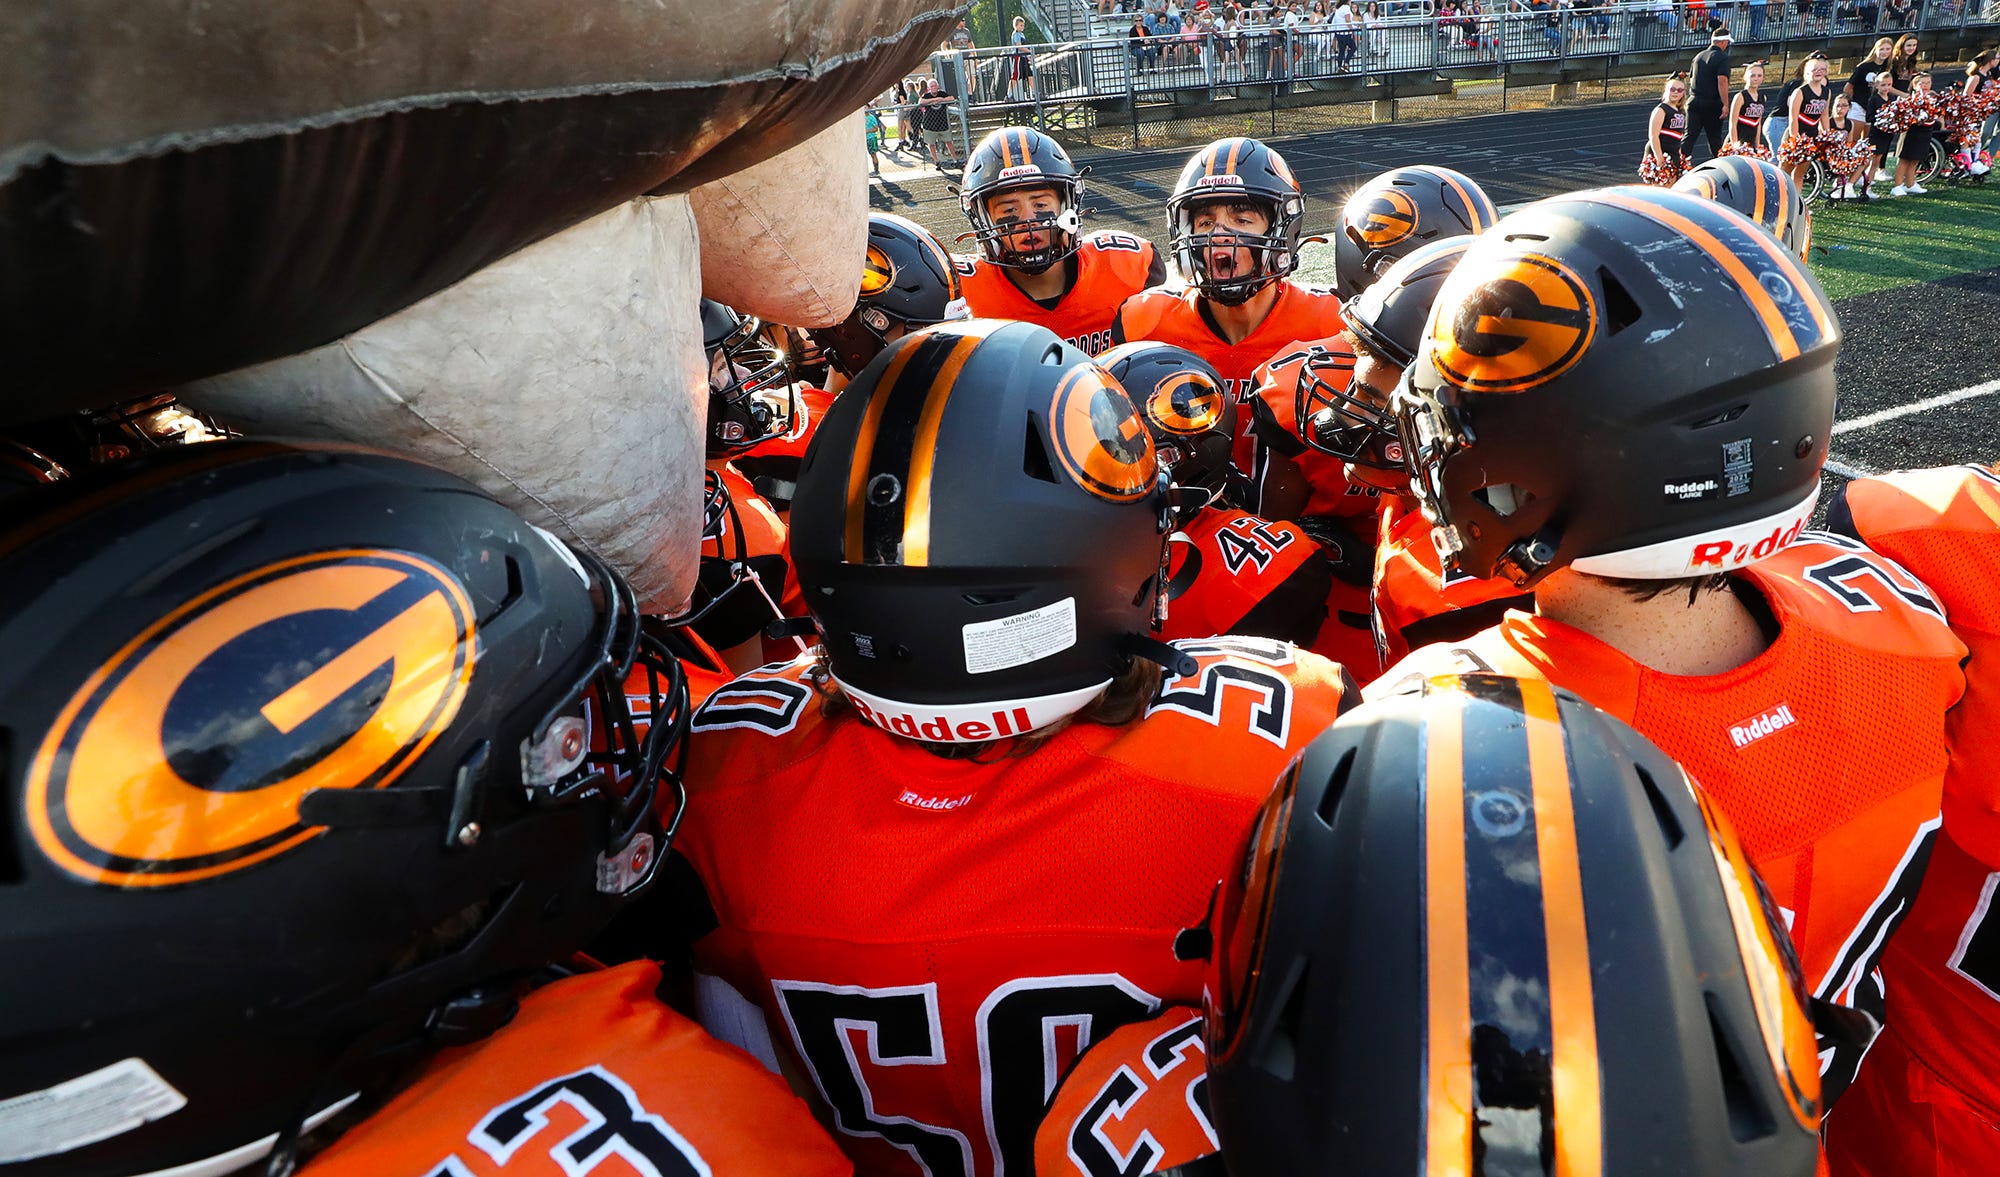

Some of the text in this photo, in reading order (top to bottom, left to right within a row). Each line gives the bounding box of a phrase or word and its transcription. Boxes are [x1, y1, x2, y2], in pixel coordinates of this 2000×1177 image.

[1201, 176, 1237, 185] Riddell
[1152, 372, 1224, 430] G
[1664, 480, 1714, 494] Riddell
[1680, 491, 1702, 499] LARGE
[1214, 516, 1296, 577] 42
[1002, 611, 1041, 627] WARNING
[65, 563, 465, 861] G
[846, 691, 1033, 741] Riddell
[1730, 705, 1795, 747] Riddell
[900, 790, 973, 810] Riddell
[771, 973, 1161, 1177] 50
[421, 1064, 712, 1177] 3
